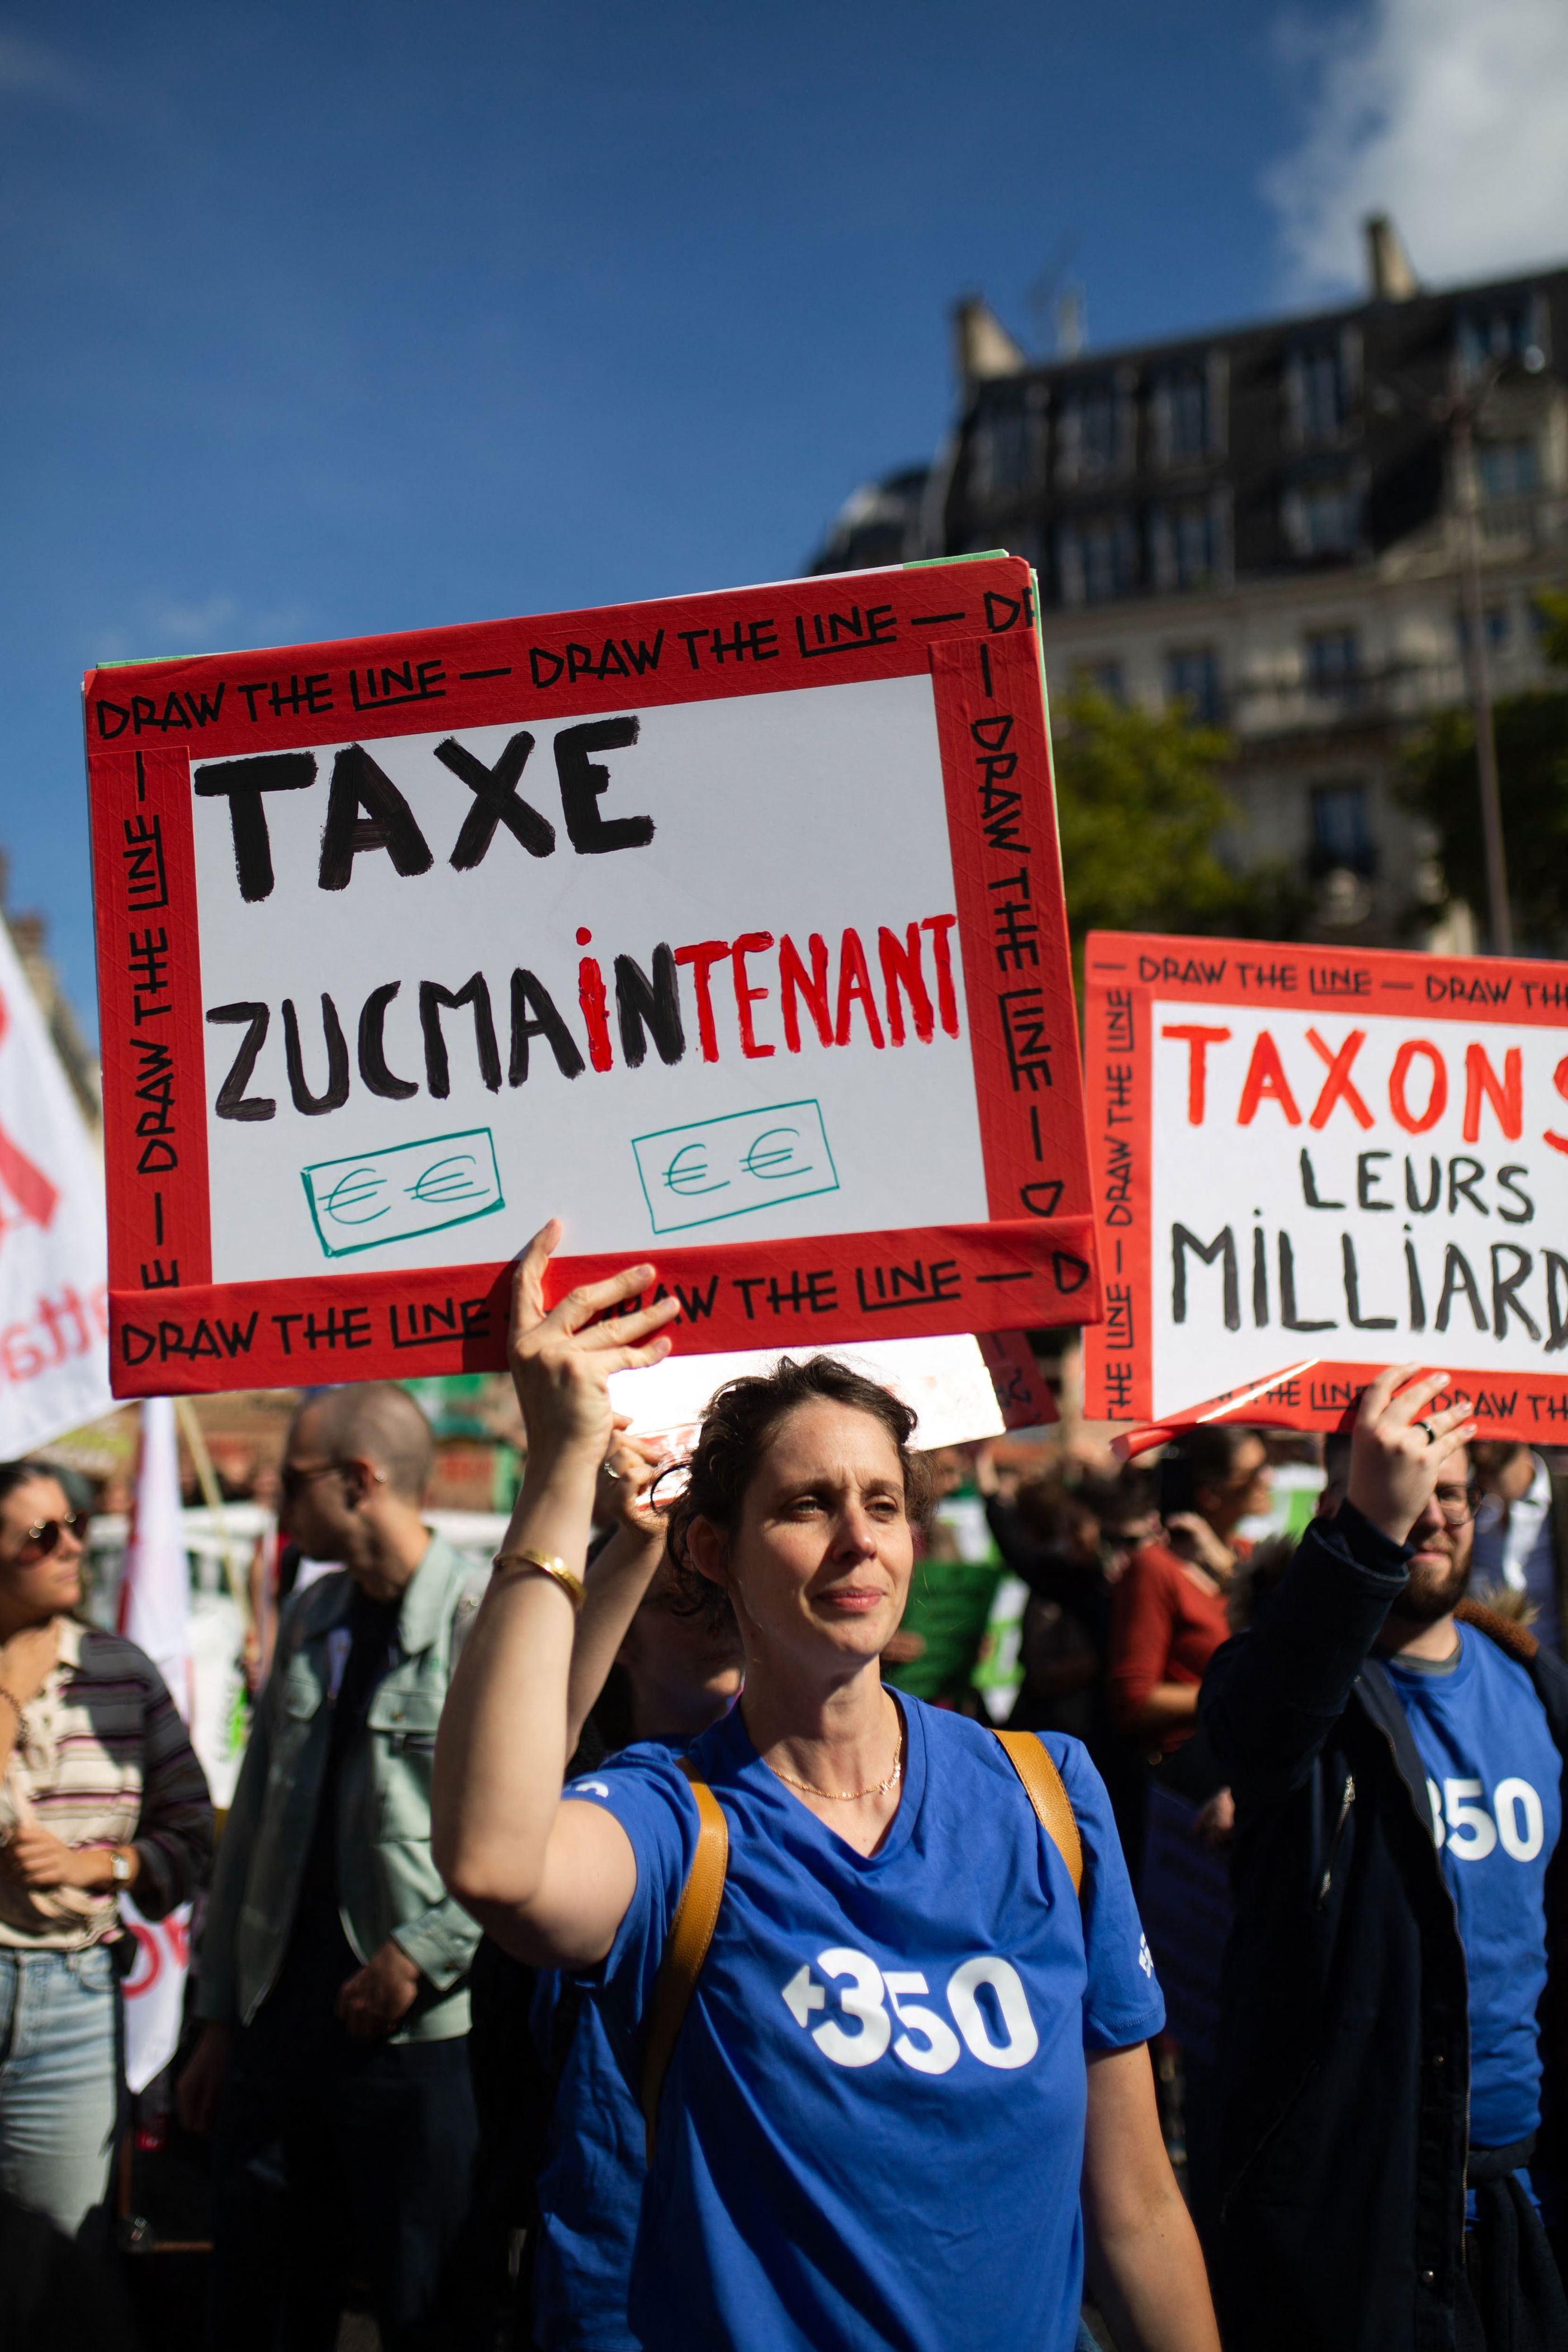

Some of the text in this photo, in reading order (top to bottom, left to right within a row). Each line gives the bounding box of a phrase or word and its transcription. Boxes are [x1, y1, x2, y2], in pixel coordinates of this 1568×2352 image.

[96, 682, 225, 740] DRAW
[237, 673, 333, 722] THE
[349, 660, 446, 711] LINE
[529, 629, 664, 688] DRAW
[678, 619, 779, 669] THE
[795, 605, 897, 658] LINE
[195, 714, 657, 904] TAXE
[971, 714, 1031, 853] DRAW
[123, 815, 168, 911] LINE
[988, 867, 1039, 972] THE
[129, 927, 172, 1026] THE
[1107, 990, 1134, 1052] LINE
[1139, 955, 1228, 988] DRAW
[1237, 964, 1295, 990] THE
[1310, 968, 1370, 995] LINE
[1427, 976, 1512, 1004] DRAW
[998, 988, 1052, 1091] LINE
[130, 1039, 177, 1174] DRAW
[1107, 1066, 1132, 1126] THE
[1105, 1137, 1132, 1225] DRAW
[1300, 1148, 1534, 1224] LEURS
[121, 1312, 258, 1366] DRAW
[272, 1307, 371, 1354] THE
[390, 1298, 491, 1349] LINE
[733, 1271, 837, 1319] THE
[856, 1261, 961, 1312] LINE
[1106, 1284, 1133, 1349] LINE
[1106, 1364, 1133, 1422] THE
[812, 1947, 1039, 2075] 350
